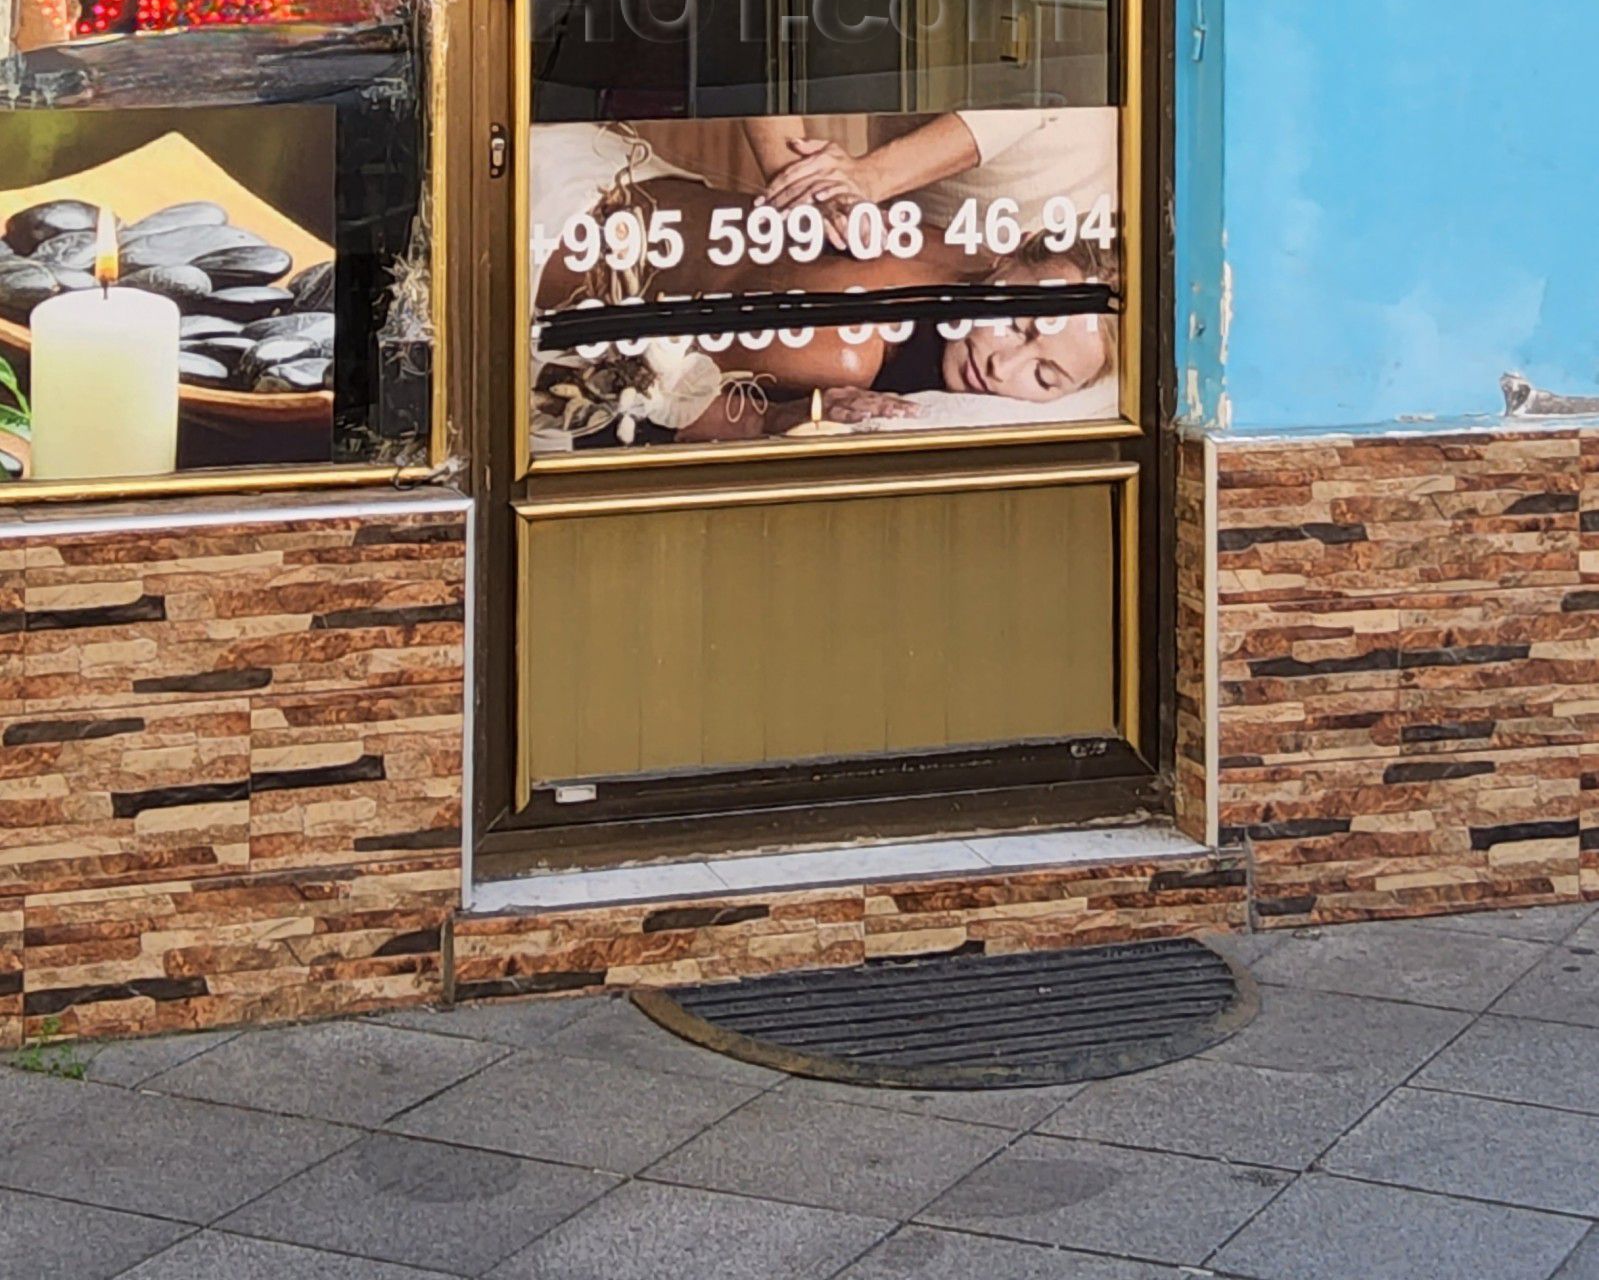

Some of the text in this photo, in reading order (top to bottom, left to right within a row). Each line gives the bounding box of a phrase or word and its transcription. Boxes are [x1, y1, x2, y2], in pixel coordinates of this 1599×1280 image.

[531, 193, 1116, 272] +995 599 08 46 94
